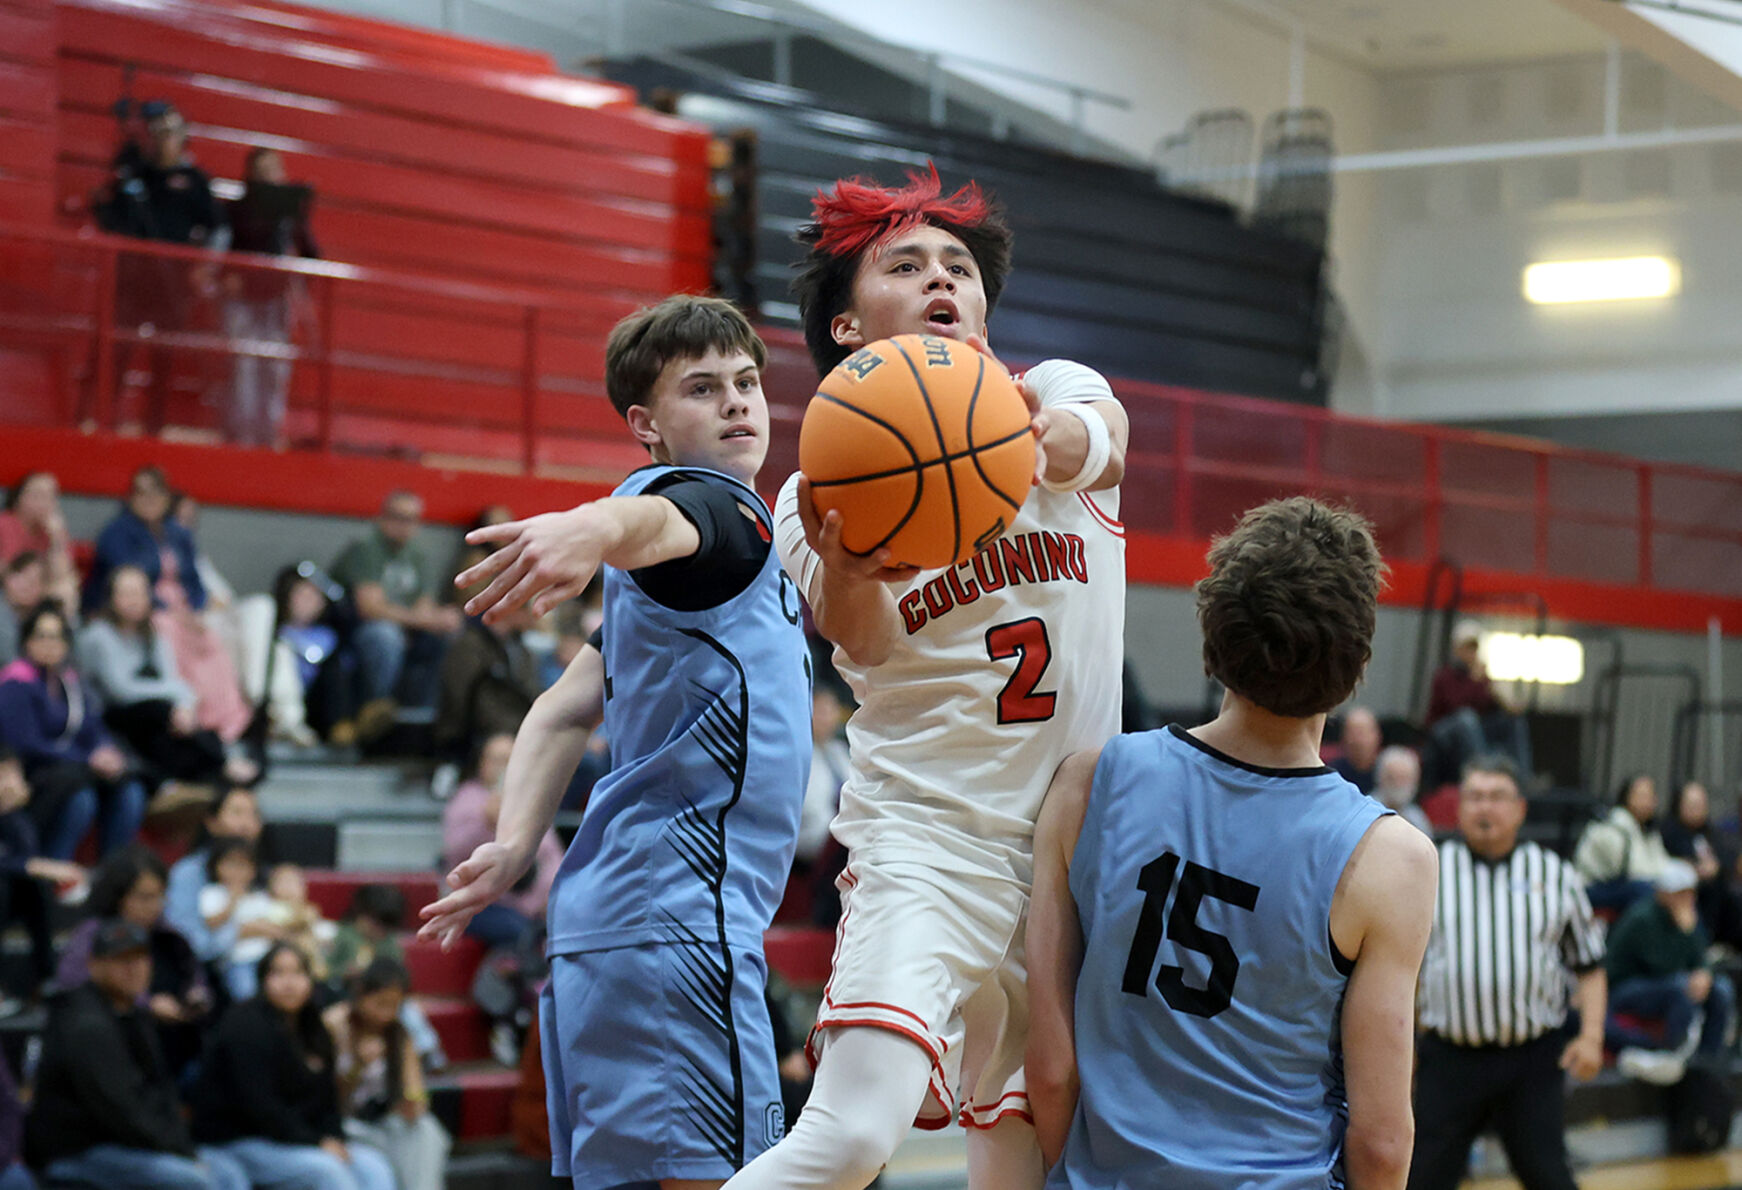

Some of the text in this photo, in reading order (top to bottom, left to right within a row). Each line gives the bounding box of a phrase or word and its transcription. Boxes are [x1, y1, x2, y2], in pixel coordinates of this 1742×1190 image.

[898, 530, 1089, 636] COCONINO
[985, 615, 1057, 725] 2
[1121, 851, 1261, 1020] 15
